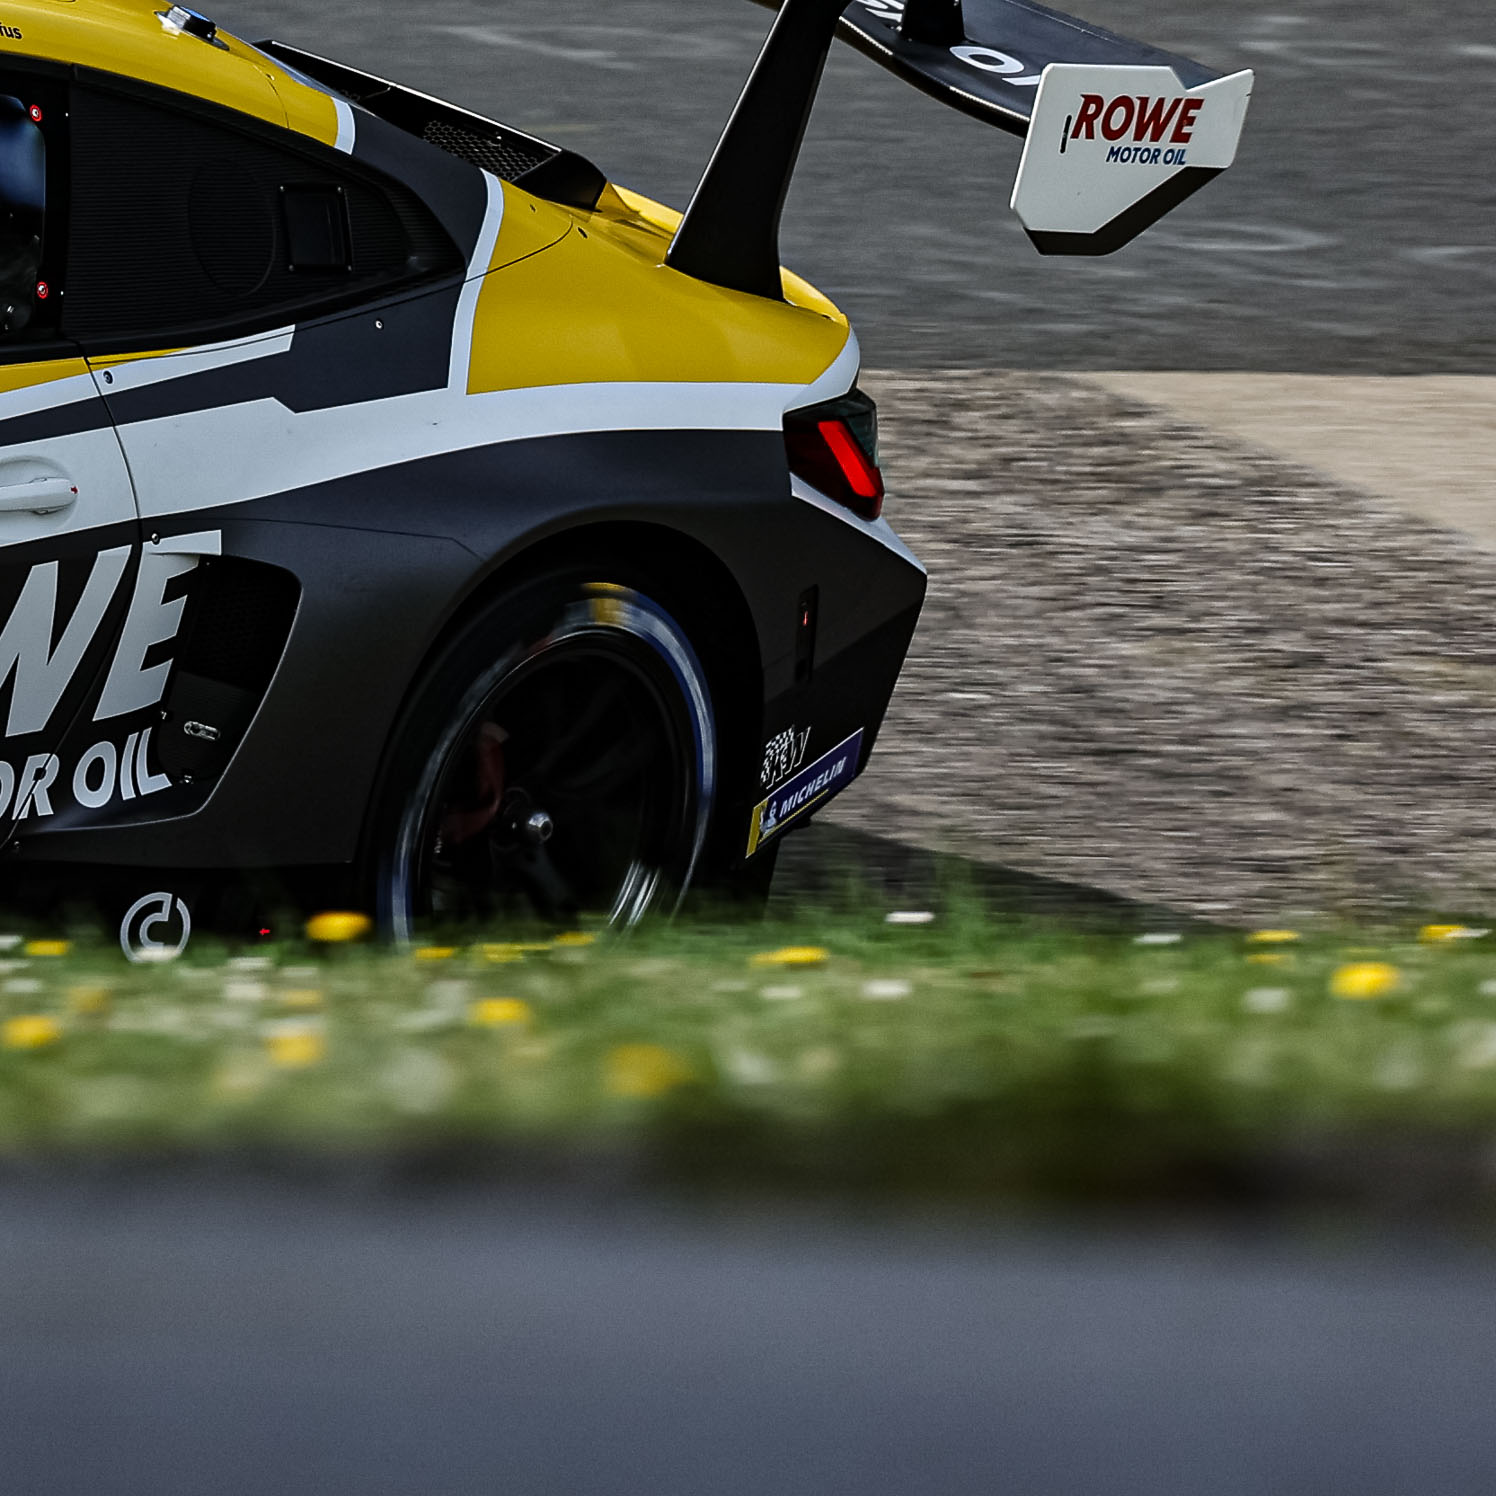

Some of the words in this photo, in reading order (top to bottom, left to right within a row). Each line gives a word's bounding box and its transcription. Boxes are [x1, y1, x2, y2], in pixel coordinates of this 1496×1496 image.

[1071, 93, 1205, 144] ROWE
[1106, 145, 1161, 166] MOTOR
[1162, 147, 1186, 166] OIL
[72, 728, 173, 809] OIL
[779, 755, 848, 818] MICHELIN
